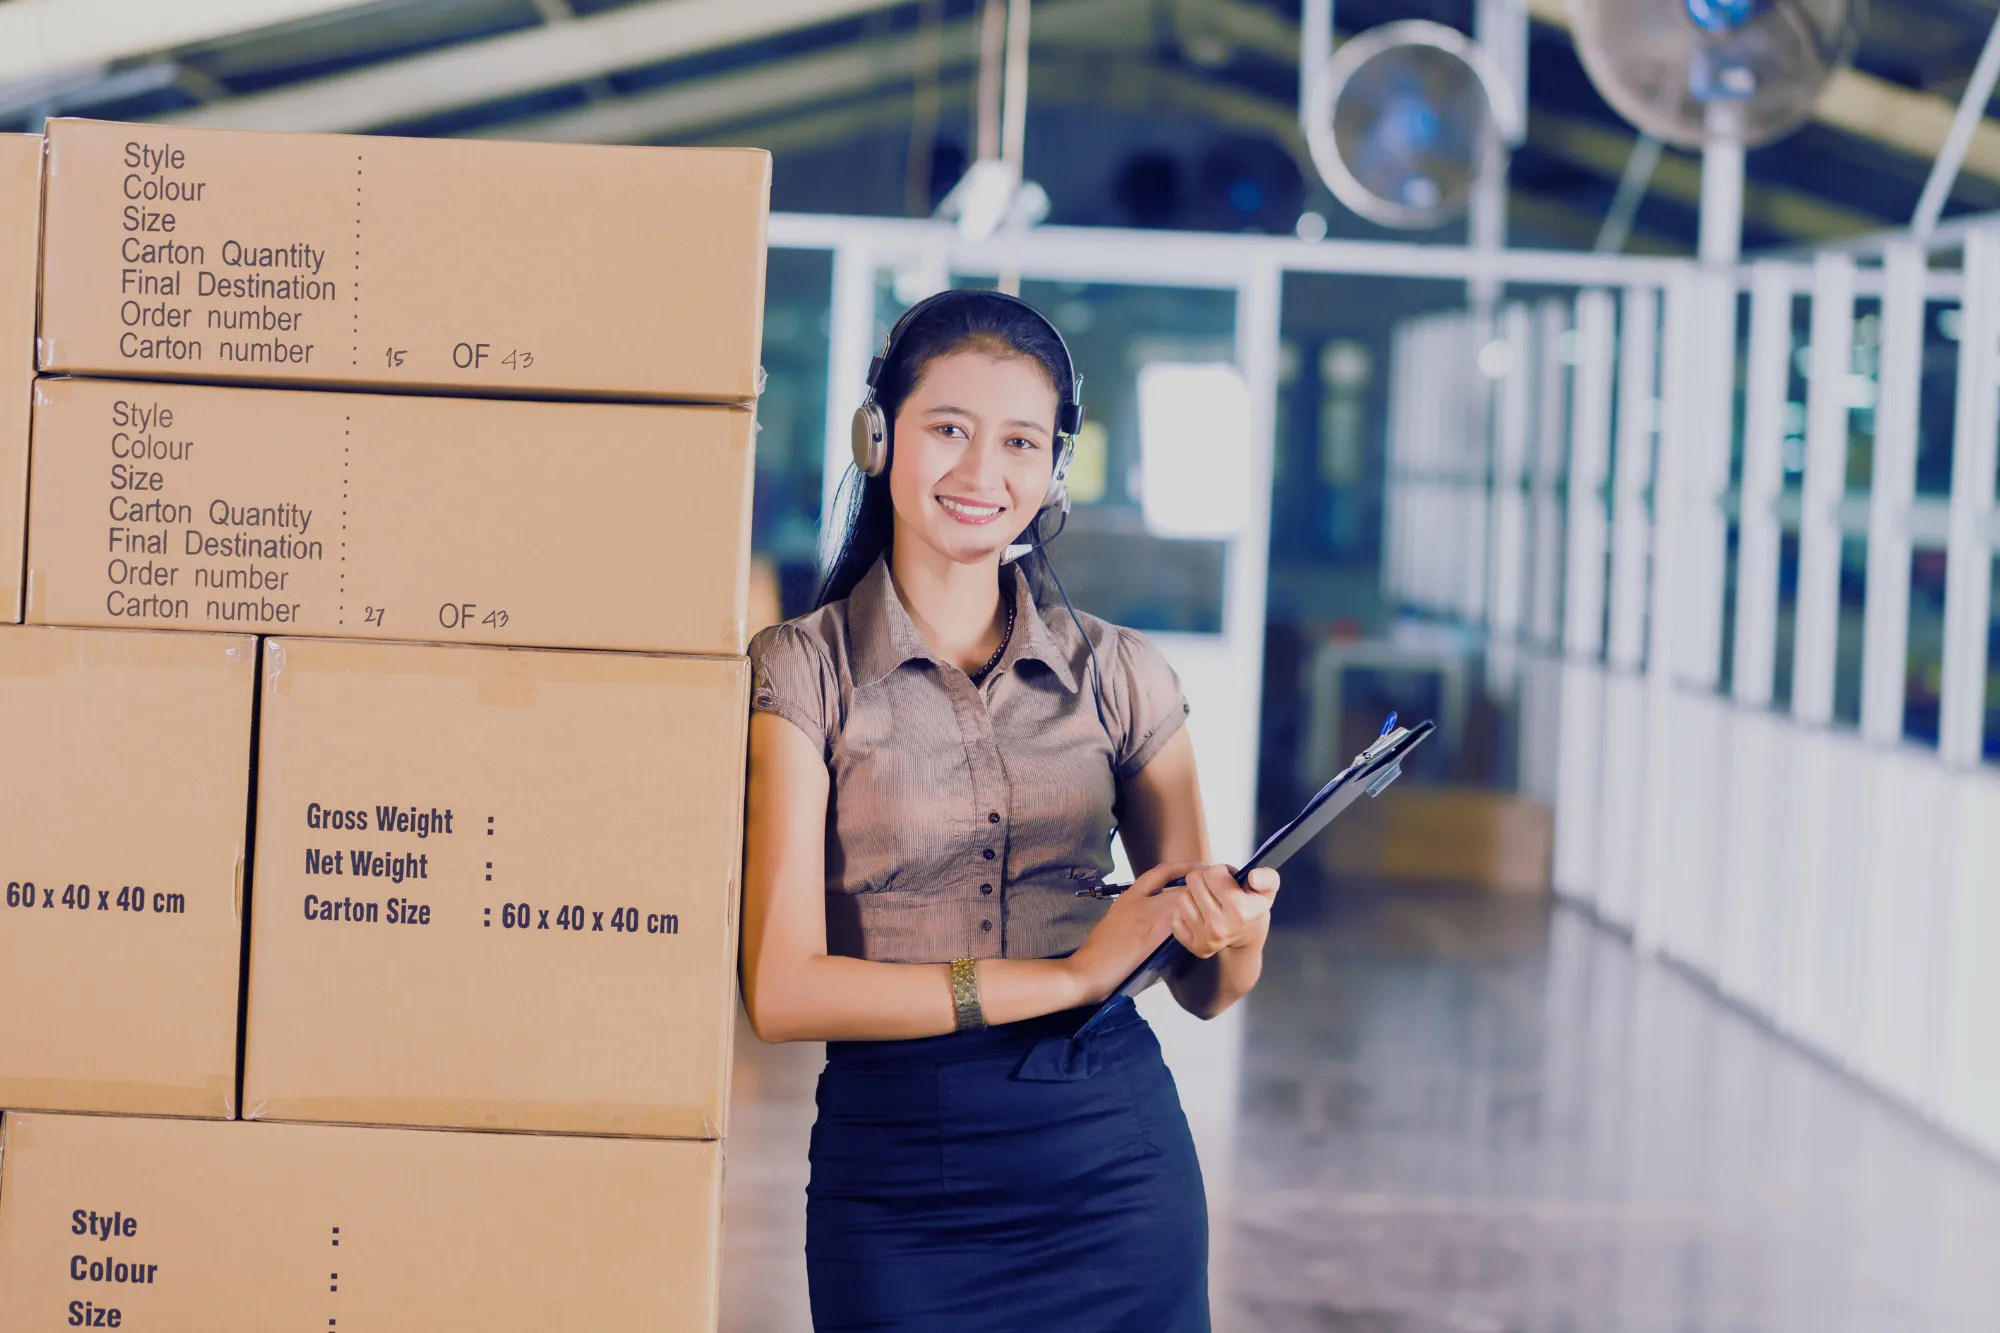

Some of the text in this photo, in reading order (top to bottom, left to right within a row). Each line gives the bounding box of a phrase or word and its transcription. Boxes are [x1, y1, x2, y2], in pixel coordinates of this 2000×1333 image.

[124, 142, 185, 175] Style
[124, 174, 206, 201] Colour
[123, 205, 175, 232] Size
[122, 237, 204, 264] Carton
[222, 240, 325, 275] Quantity
[122, 269, 180, 295] Final
[198, 271, 335, 300] Destination
[121, 300, 192, 328] Order
[208, 305, 302, 331] number
[120, 332, 201, 360] Carton
[220, 337, 314, 363] number
[386, 347, 407, 369] 15
[453, 343, 490, 369] OF
[501, 349, 534, 370] 43
[112, 401, 173, 434] Style
[112, 432, 194, 460] Colour
[111, 464, 163, 491] Size
[109, 496, 191, 523] Carton
[209, 499, 312, 535] Quantity
[109, 527, 167, 554] Final
[186, 530, 322, 560] Destination
[108, 559, 179, 586] Order
[195, 564, 289, 590] number
[107, 590, 188, 618] Carton
[207, 596, 300, 622] number
[364, 606, 385, 627] 27
[439, 603, 476, 629] OF
[482, 610, 509, 629] 43
[307, 803, 368, 830] Gross
[376, 806, 453, 838] Weight
[306, 848, 343, 875] Net
[350, 850, 428, 884] Weight
[6, 882, 185, 913] 60 x 40 x 40 cm
[304, 894, 378, 923] Carton
[386, 898, 430, 925] Size
[502, 903, 530, 929] 60
[537, 910, 549, 930] x
[556, 905, 584, 931] 40
[592, 912, 604, 931] x
[611, 907, 639, 932] 40
[647, 914, 678, 934] cm
[72, 1209, 137, 1241] Style
[71, 1255, 158, 1284] Colour
[68, 1300, 121, 1328] Size
